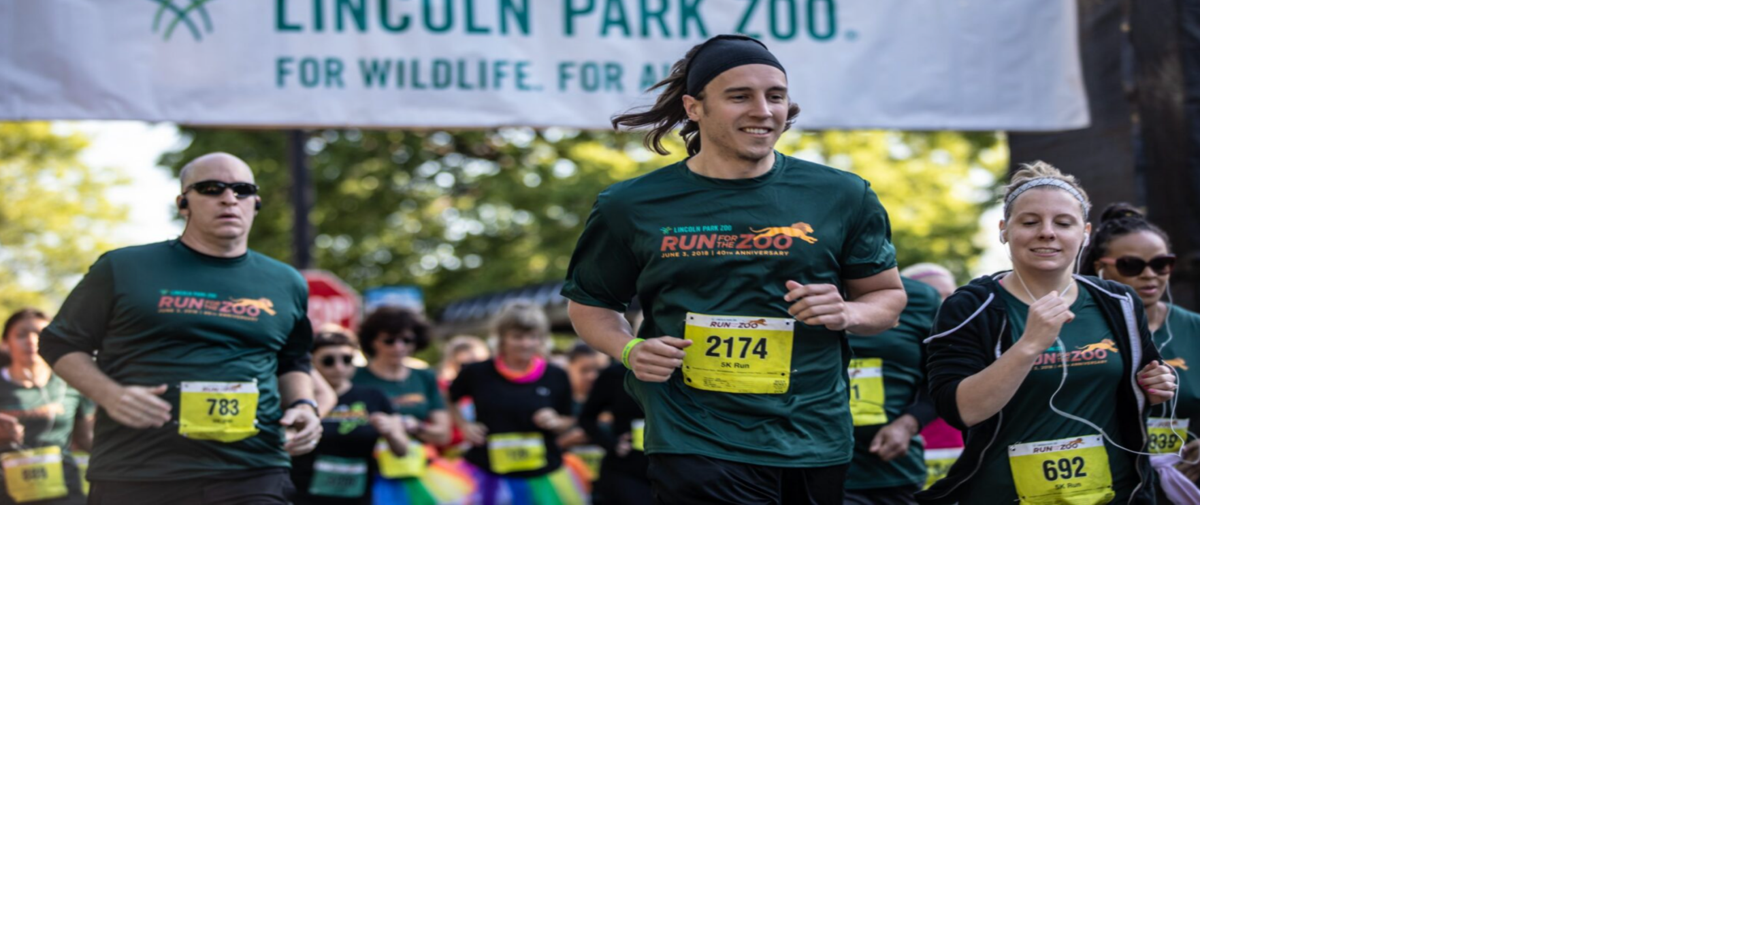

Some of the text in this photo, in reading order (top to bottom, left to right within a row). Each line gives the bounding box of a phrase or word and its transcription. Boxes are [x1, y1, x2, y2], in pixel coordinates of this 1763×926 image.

[274, 0, 838, 41] LINCOLN PARK ZOO
[275, 56, 346, 89] FOR
[359, 57, 543, 92] WILDLIFE.
[558, 60, 622, 92] FOR
[720, 224, 733, 232] ZOO
[660, 233, 793, 251] RUN FOR THE ZOO
[158, 296, 205, 310] RUN
[219, 300, 261, 317] ZOO
[705, 335, 768, 359] 2174
[1033, 352, 1057, 366] UN
[1071, 348, 1108, 362] ZOO
[206, 398, 240, 417] 783
[1033, 445, 1053, 454] RUN
[1060, 442, 1079, 451] ZOO
[1042, 455, 1088, 482] 692
